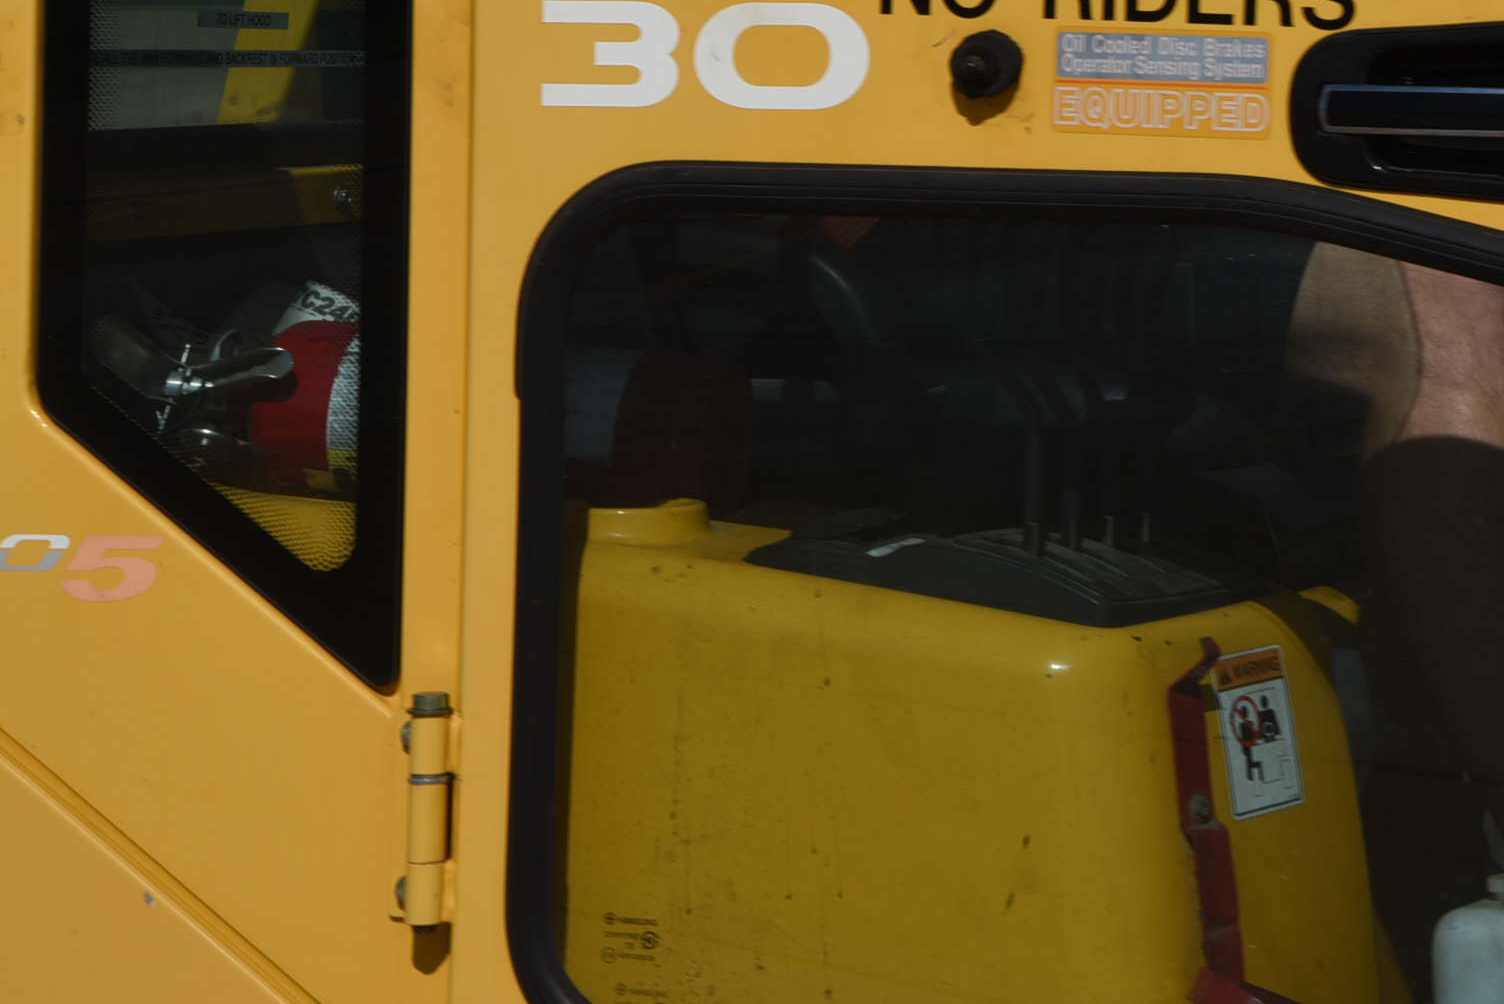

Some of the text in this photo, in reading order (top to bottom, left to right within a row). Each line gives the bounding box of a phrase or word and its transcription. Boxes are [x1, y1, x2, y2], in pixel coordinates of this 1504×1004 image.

[540, 0, 871, 110] 30
[1061, 33, 1267, 59] Oil Cooled Disc Brakes
[1061, 53, 1265, 81] Operator Sensing System
[1053, 87, 1272, 132] EQUIPPED
